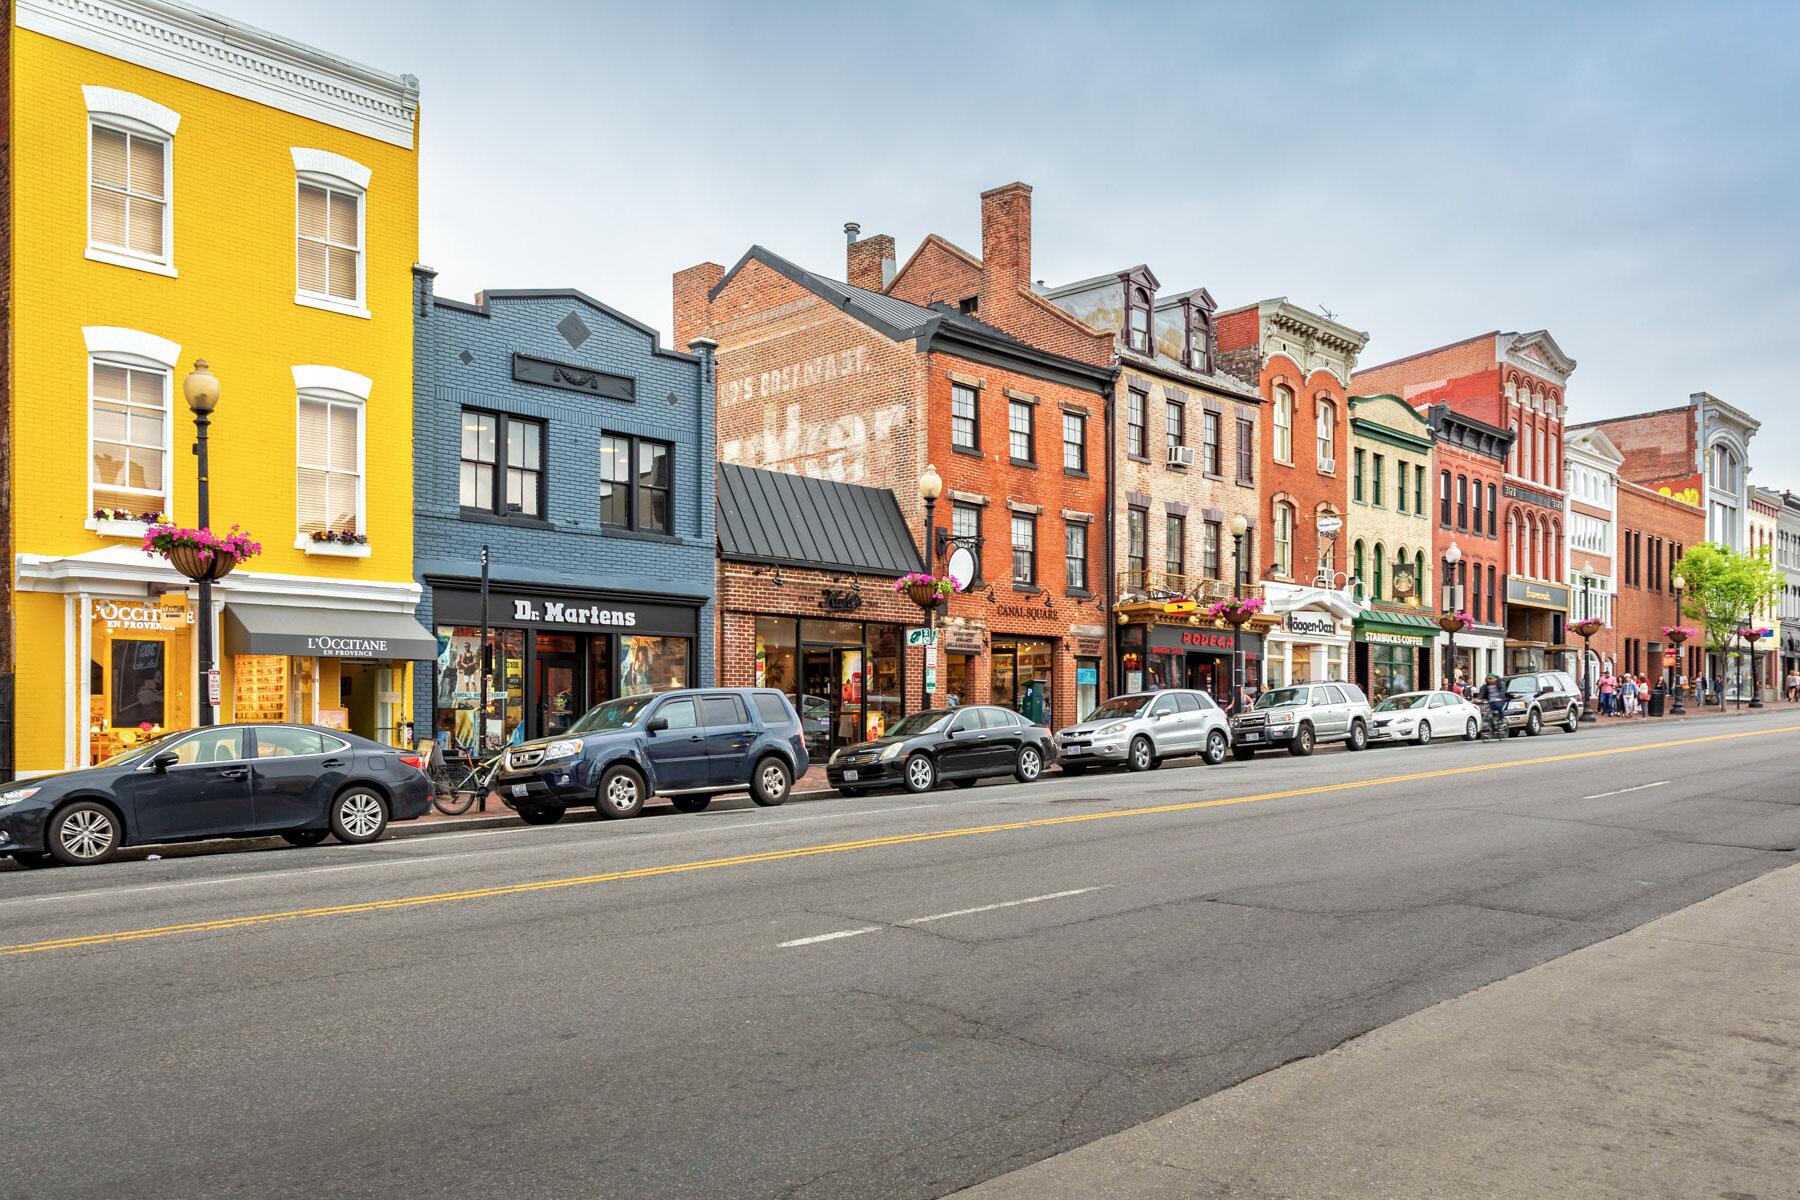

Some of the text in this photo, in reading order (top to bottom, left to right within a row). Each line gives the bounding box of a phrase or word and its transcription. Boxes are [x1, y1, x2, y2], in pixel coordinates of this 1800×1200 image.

[514, 599, 637, 626] Dr. Martens
[997, 604, 1060, 621] CANAL SQUARE
[107, 620, 120, 629] EN
[307, 636, 388, 651] L'OCCITANE
[1182, 631, 1234, 649] BODEGA
[1365, 631, 1424, 646] STARBUCKS COFFEE
